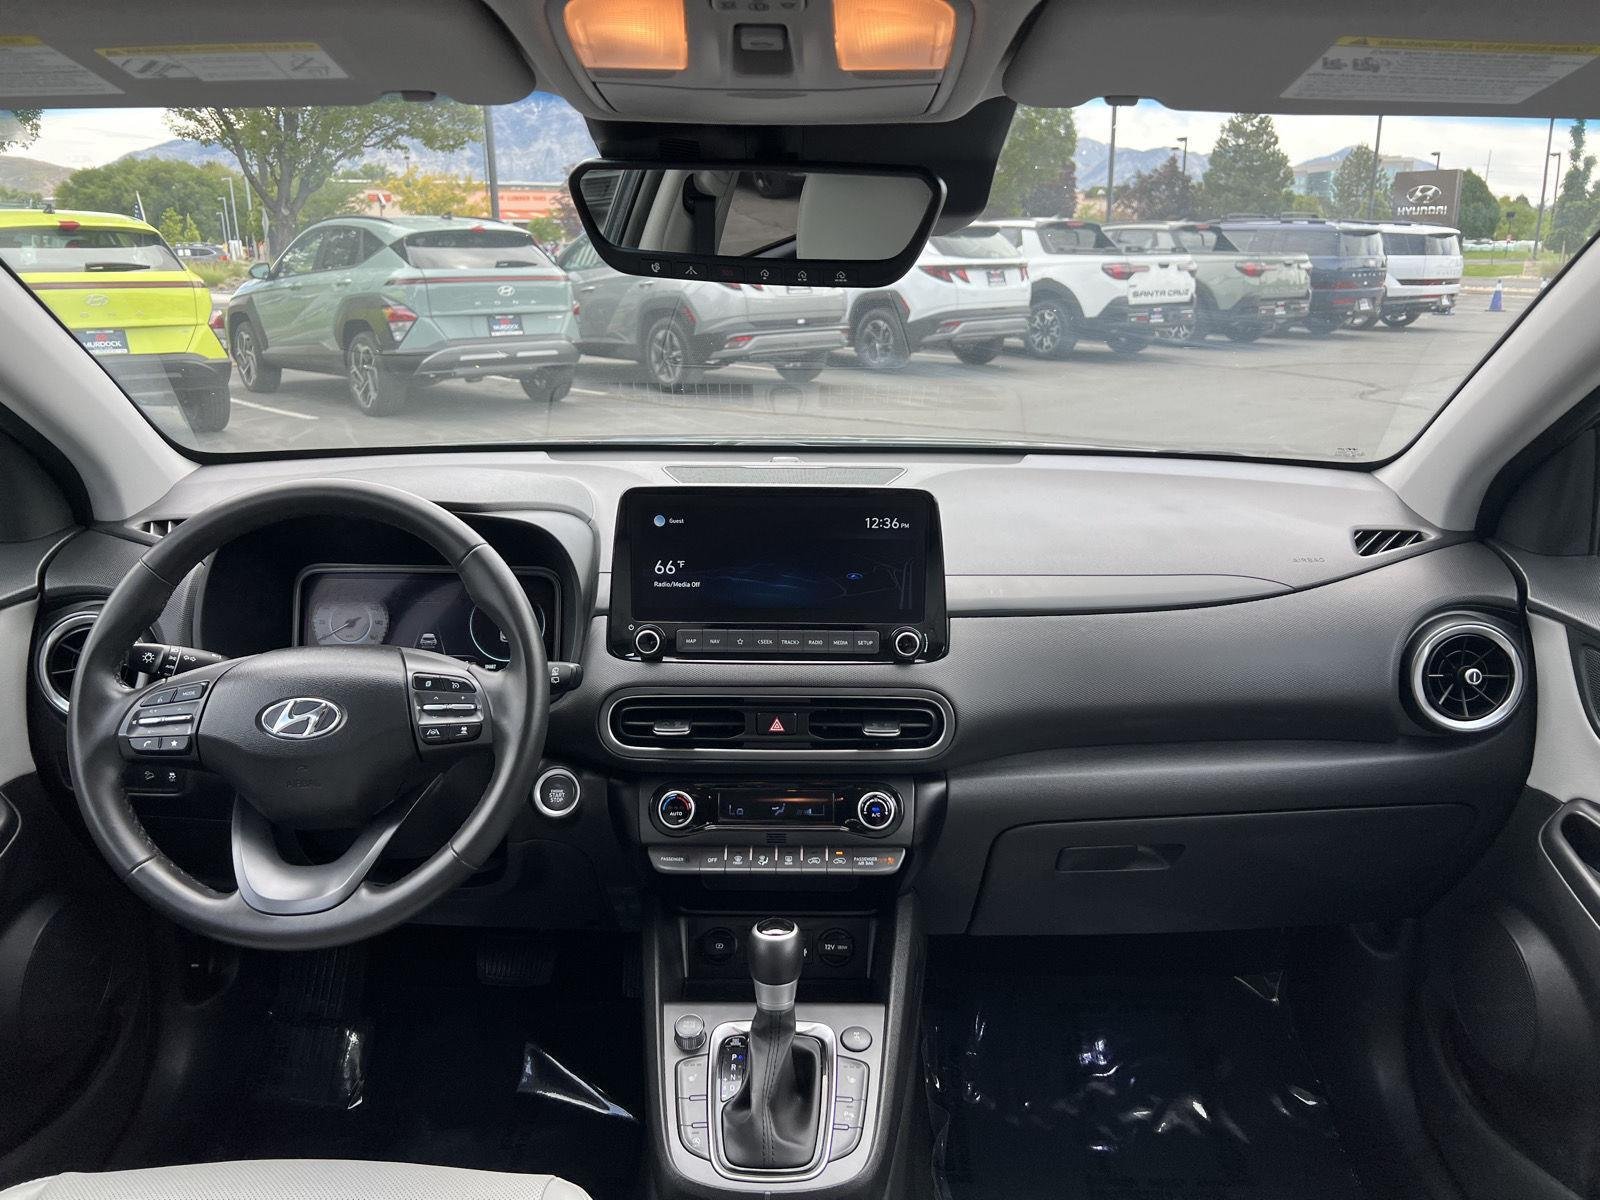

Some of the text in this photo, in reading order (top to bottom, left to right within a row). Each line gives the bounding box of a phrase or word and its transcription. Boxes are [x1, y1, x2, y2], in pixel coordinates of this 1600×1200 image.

[1397, 205, 1448, 216] HYUNDAI
[1132, 288, 1190, 298] SANTA CRUZ
[83, 340, 122, 348] MURDOCK
[864, 517, 900, 529] 12:36
[731, 1053, 738, 1061] P
[730, 1063, 737, 1071] R
[730, 1073, 736, 1081] N
